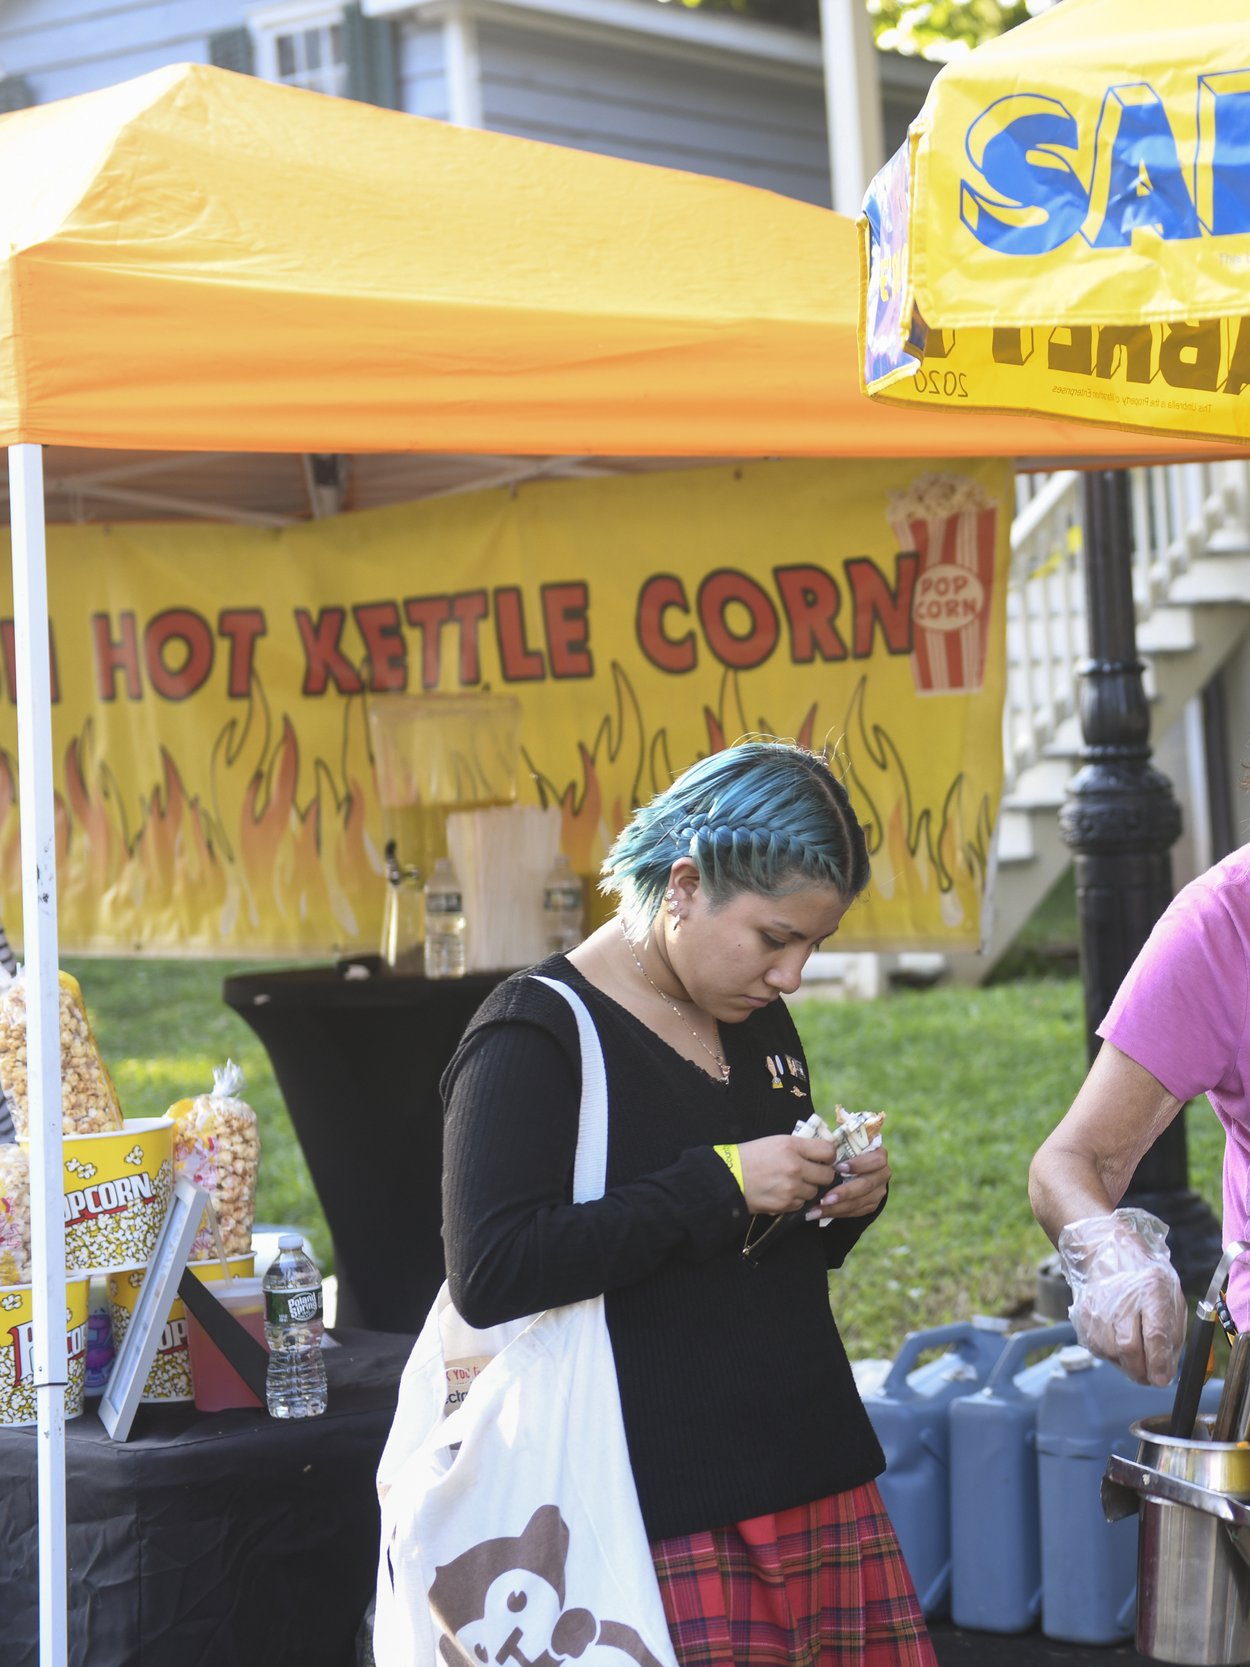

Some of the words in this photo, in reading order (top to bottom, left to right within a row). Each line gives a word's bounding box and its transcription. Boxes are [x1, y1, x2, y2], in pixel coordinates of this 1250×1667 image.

[919, 575, 969, 597] POP
[914, 599, 977, 620] CORN
[92, 606, 268, 701] HOT
[294, 580, 594, 697] KETTLE
[636, 551, 920, 676] CORN
[288, 1291, 316, 1308] Poland
